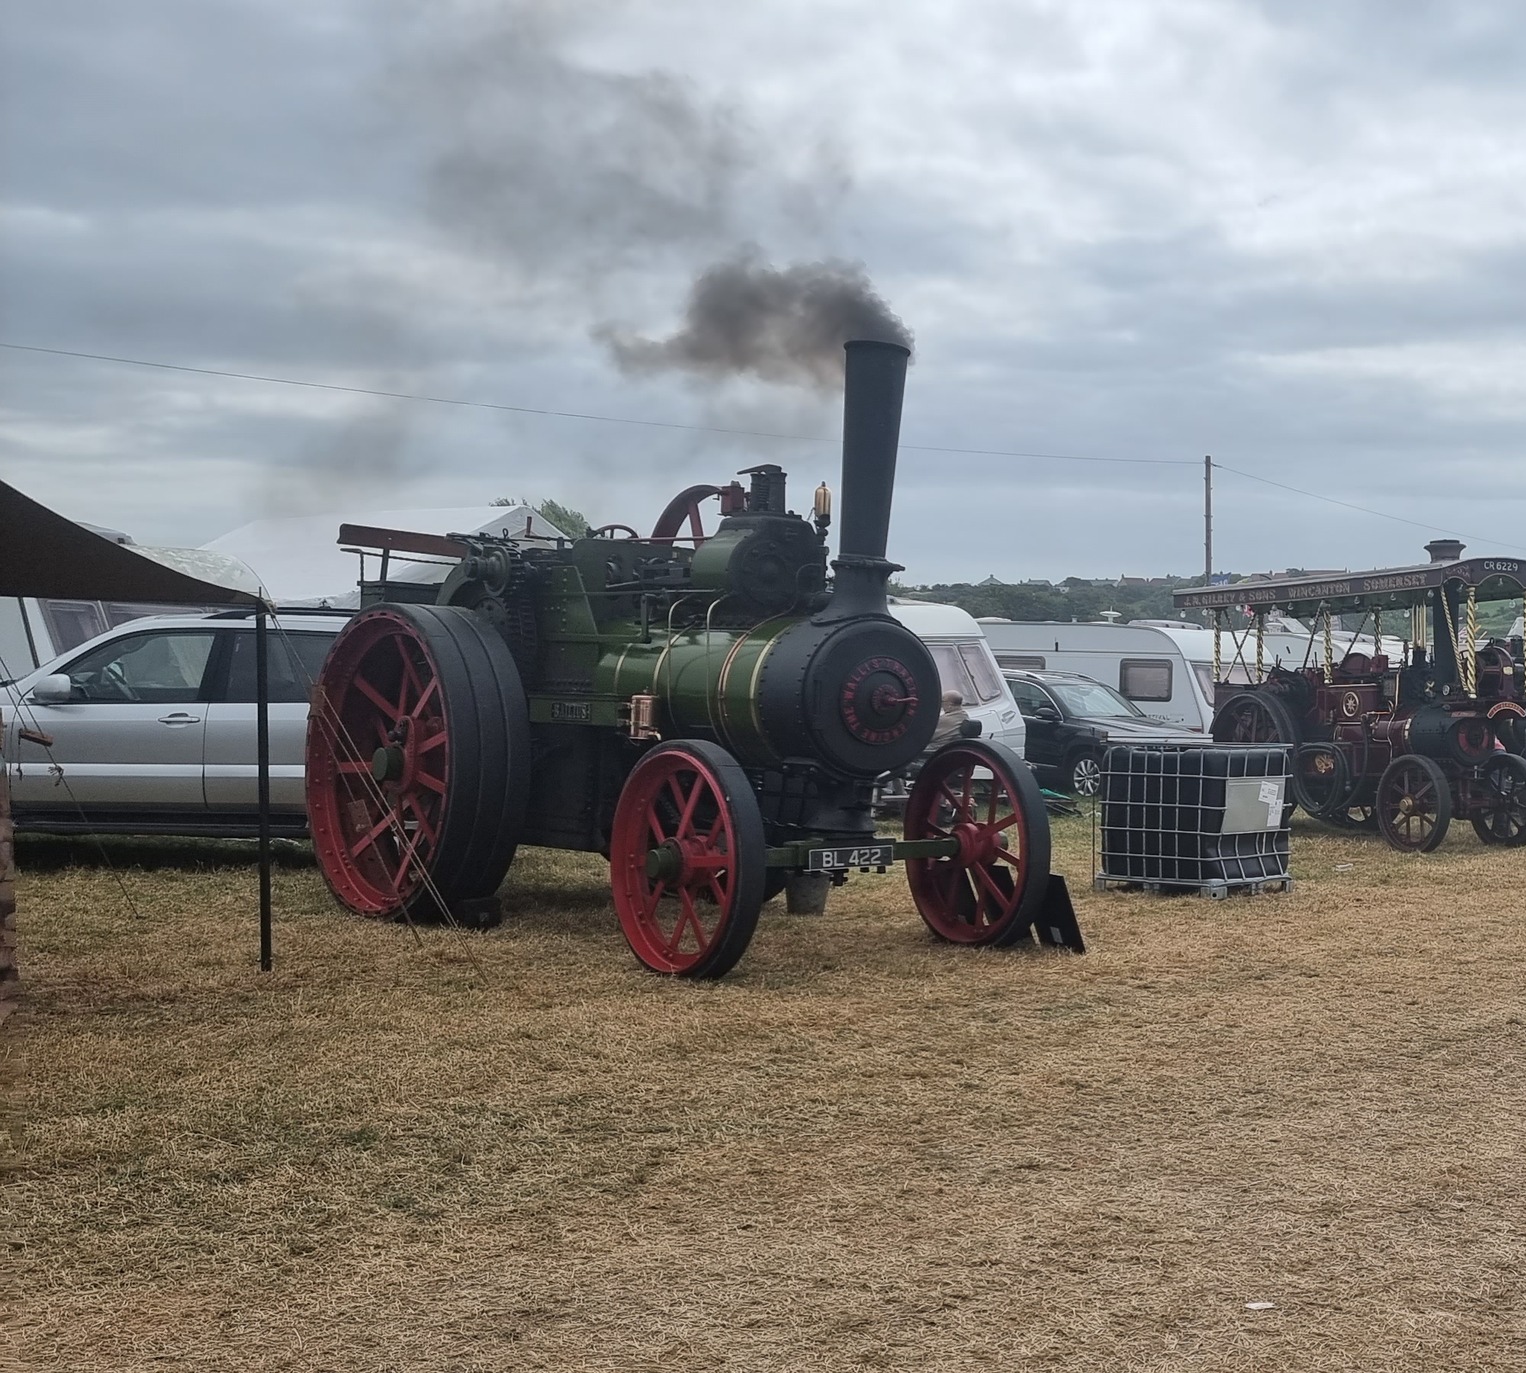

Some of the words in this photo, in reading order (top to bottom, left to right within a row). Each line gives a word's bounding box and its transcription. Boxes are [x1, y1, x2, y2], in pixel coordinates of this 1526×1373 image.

[1248, 588, 1276, 601] SONS
[1286, 582, 1351, 599] WINCANTON
[1363, 573, 1427, 592] SOMERSET
[822, 851, 845, 867] BL
[848, 849, 881, 866] 422
